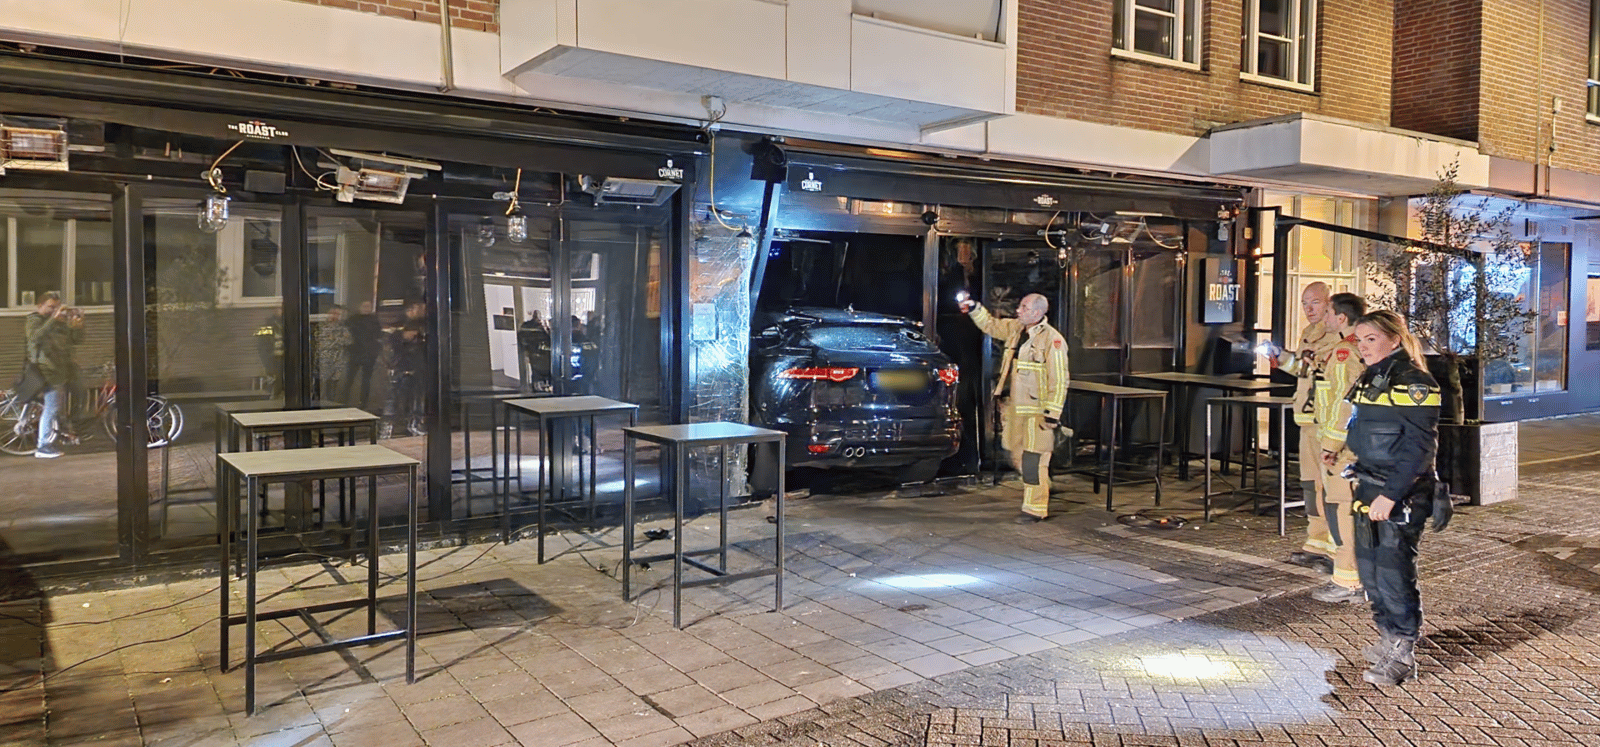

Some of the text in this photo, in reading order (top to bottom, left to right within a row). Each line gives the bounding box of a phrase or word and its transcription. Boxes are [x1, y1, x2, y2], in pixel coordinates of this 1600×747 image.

[238, 122, 276, 138] ROAST
[658, 167, 684, 179] CORNET
[801, 179, 823, 191] CORNET
[1209, 283, 1241, 301] ROAST
